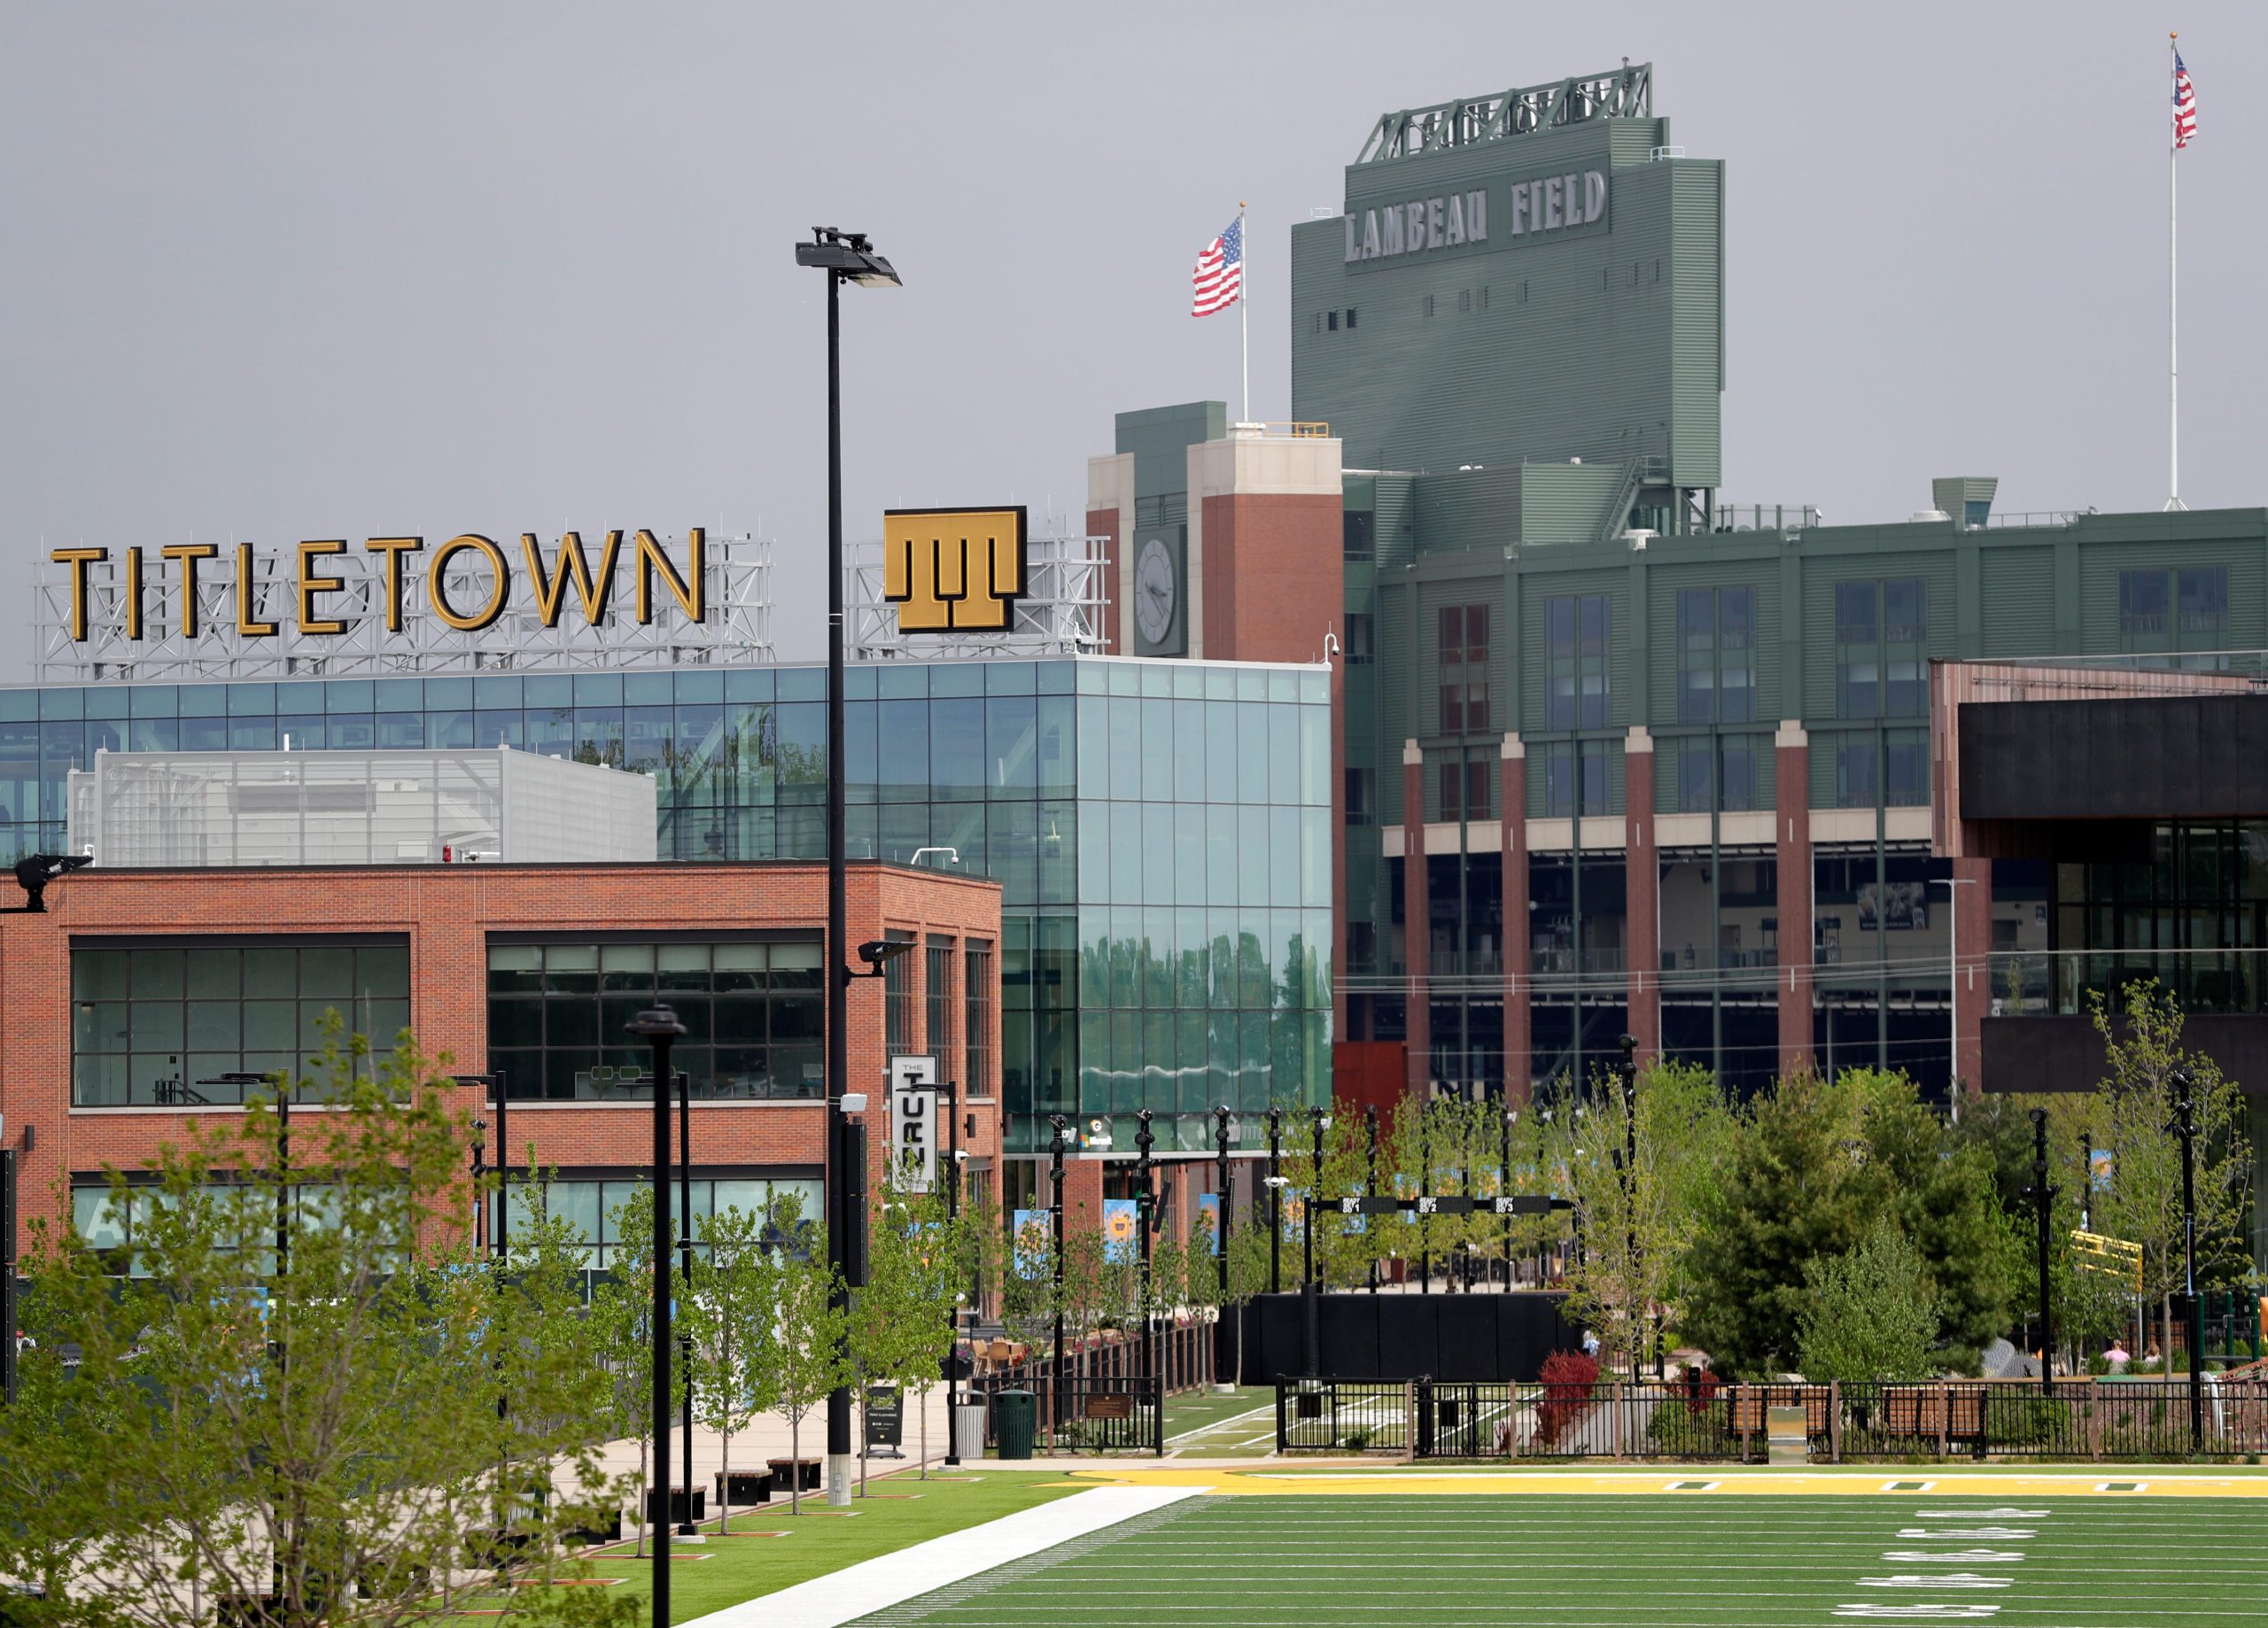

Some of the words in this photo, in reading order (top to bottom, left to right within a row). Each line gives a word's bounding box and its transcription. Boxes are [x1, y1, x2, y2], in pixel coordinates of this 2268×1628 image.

[1344, 189, 1489, 264] LAMBEAU
[1511, 168, 1607, 236] FIELD
[50, 526, 706, 642] TITLETOWN
[1355, 1203, 1360, 1212] 1
[1431, 1203, 1437, 1212] 2
[1507, 1203, 1513, 1212] 3
